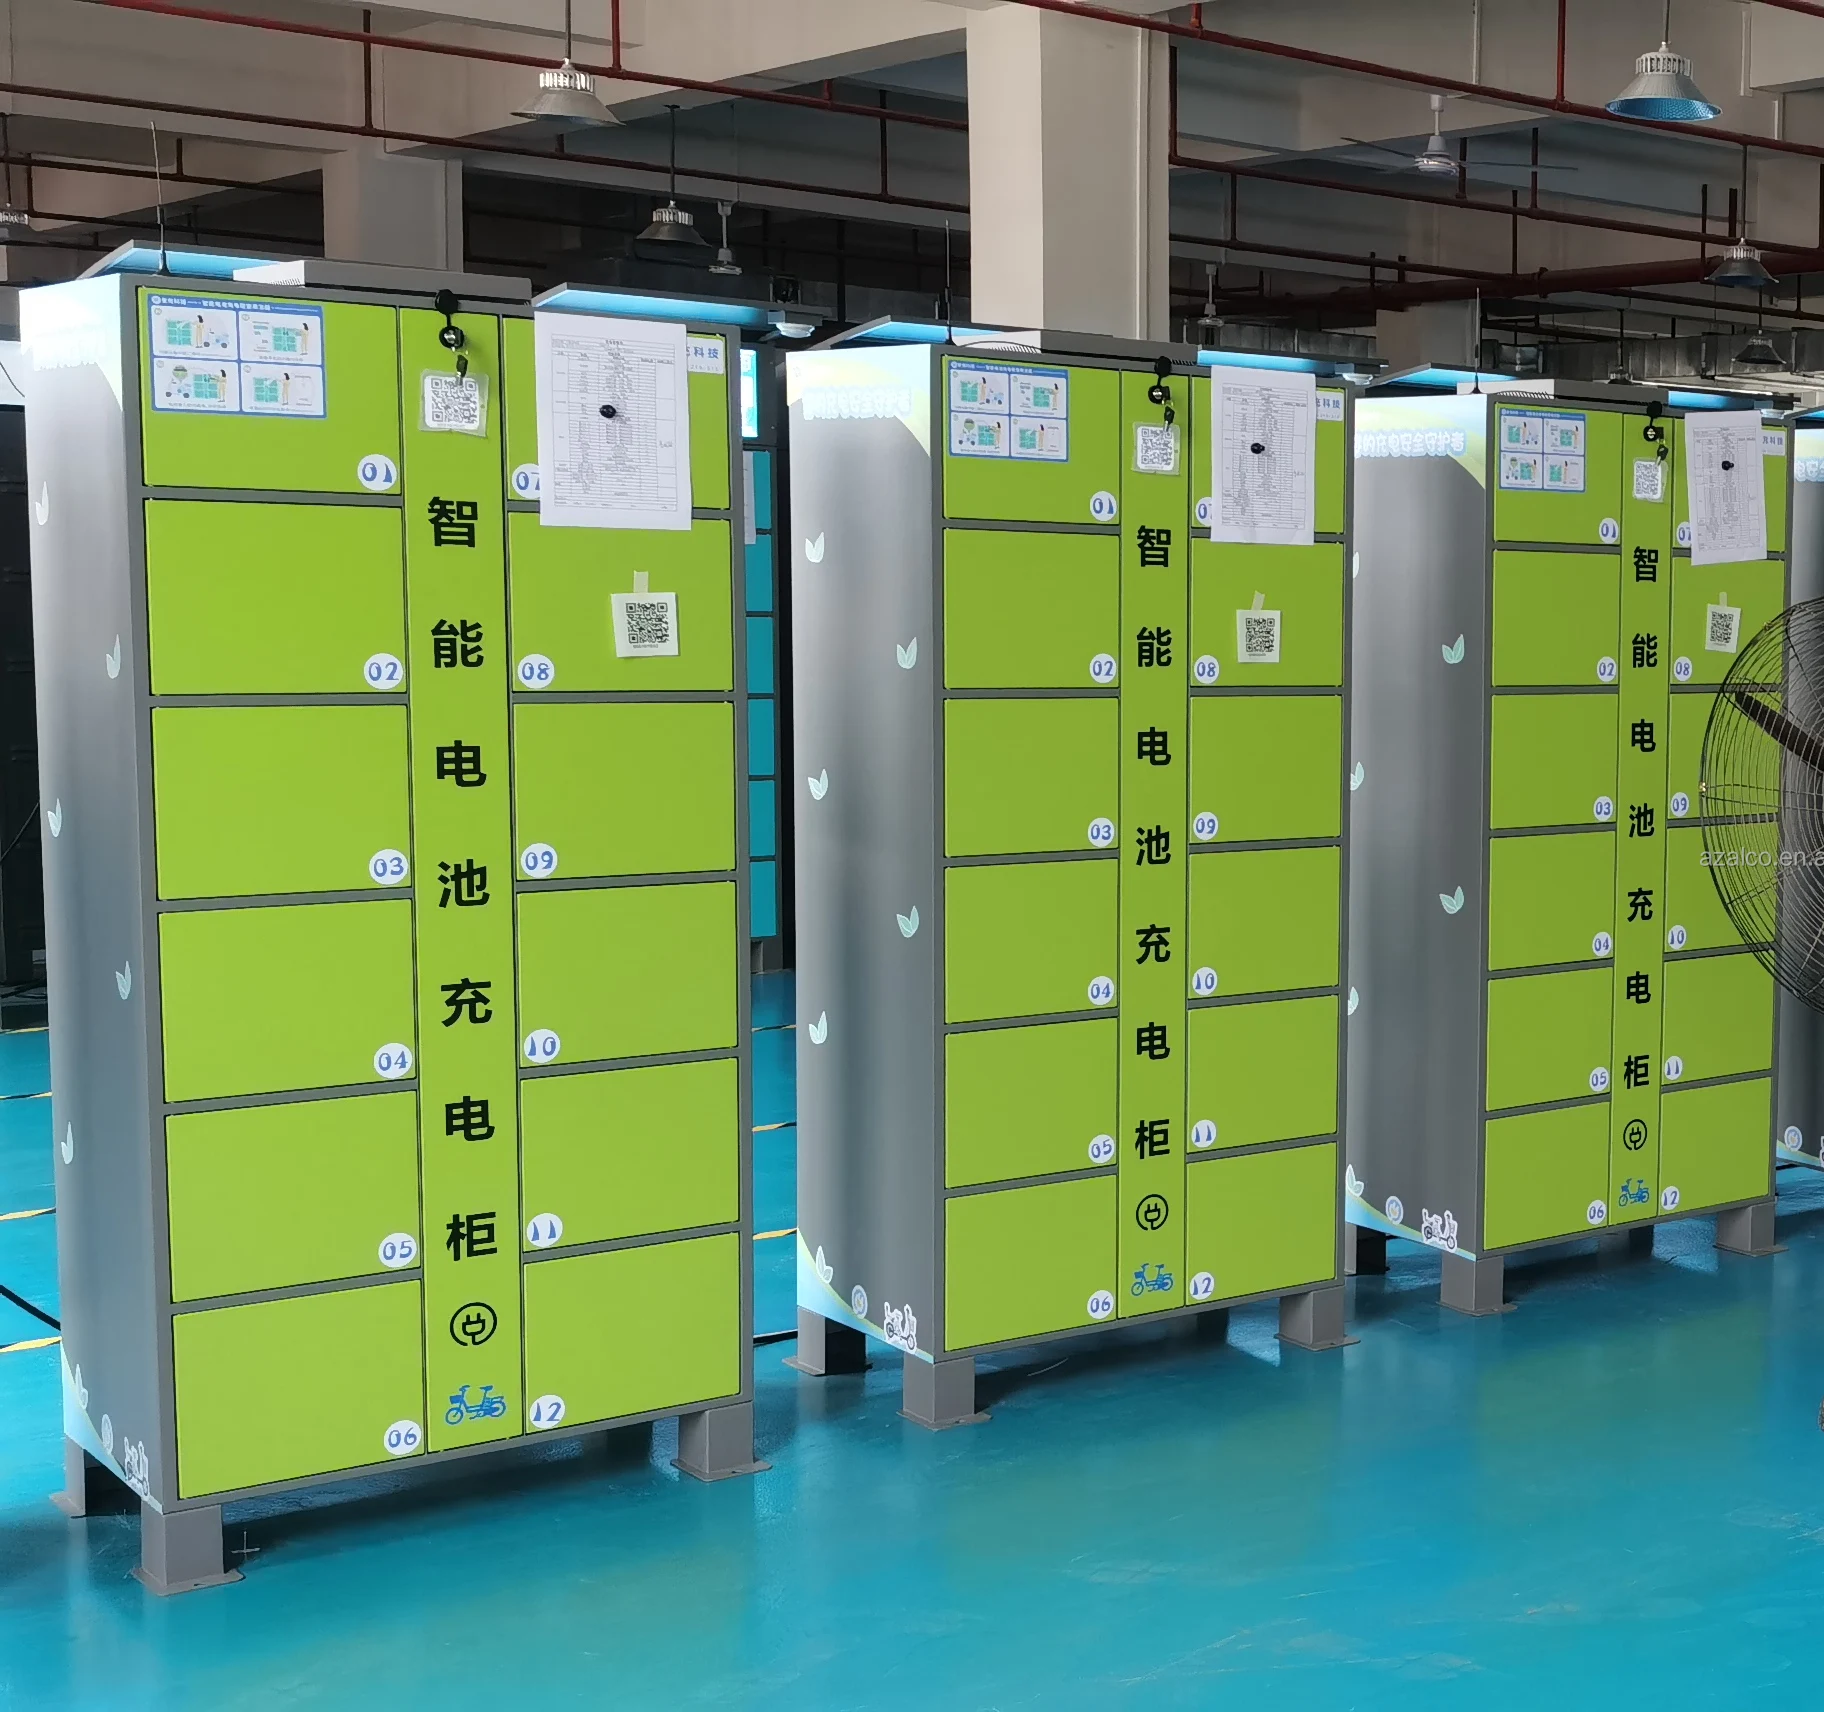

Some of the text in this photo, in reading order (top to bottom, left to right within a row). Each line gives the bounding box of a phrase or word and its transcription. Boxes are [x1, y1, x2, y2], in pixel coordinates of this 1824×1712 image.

[361, 462, 393, 484] 01
[1092, 497, 1115, 515] 01
[1601, 523, 1617, 539] 01
[368, 661, 399, 682] 02
[521, 662, 551, 681] 08
[1092, 660, 1114, 677] 02
[1196, 661, 1217, 678] 08
[1598, 662, 1615, 677] 02
[1675, 662, 1690, 676] 08
[1595, 801, 1611, 816] 03
[1672, 797, 1687, 812] 09
[1195, 817, 1216, 835] 09
[1624, 547, 1659, 1090] 智能电池充电柜
[1090, 823, 1112, 841] 03
[1134, 525, 1172, 1160] 智能电池充电柜
[373, 856, 405, 878] 03
[524, 850, 554, 871] 09
[428, 496, 498, 1261] 智能电池充电柜
[1594, 937, 1610, 952] 04
[1670, 929, 1685, 945] 10
[1194, 972, 1215, 990] 10
[1090, 982, 1111, 1000] 04
[527, 1036, 557, 1057] 10
[378, 1050, 409, 1072] 04
[1666, 1060, 1680, 1076] 11
[1591, 1071, 1607, 1087] 05
[1194, 1125, 1212, 1143] 11
[1090, 1140, 1112, 1158] 05
[1663, 1190, 1678, 1207] 12
[1588, 1204, 1605, 1220] 06
[530, 1220, 557, 1242] 11
[382, 1240, 413, 1261] 05
[1192, 1276, 1212, 1296] 12
[1090, 1295, 1111, 1314] 06
[532, 1401, 562, 1422] 12
[387, 1426, 418, 1449] 06
